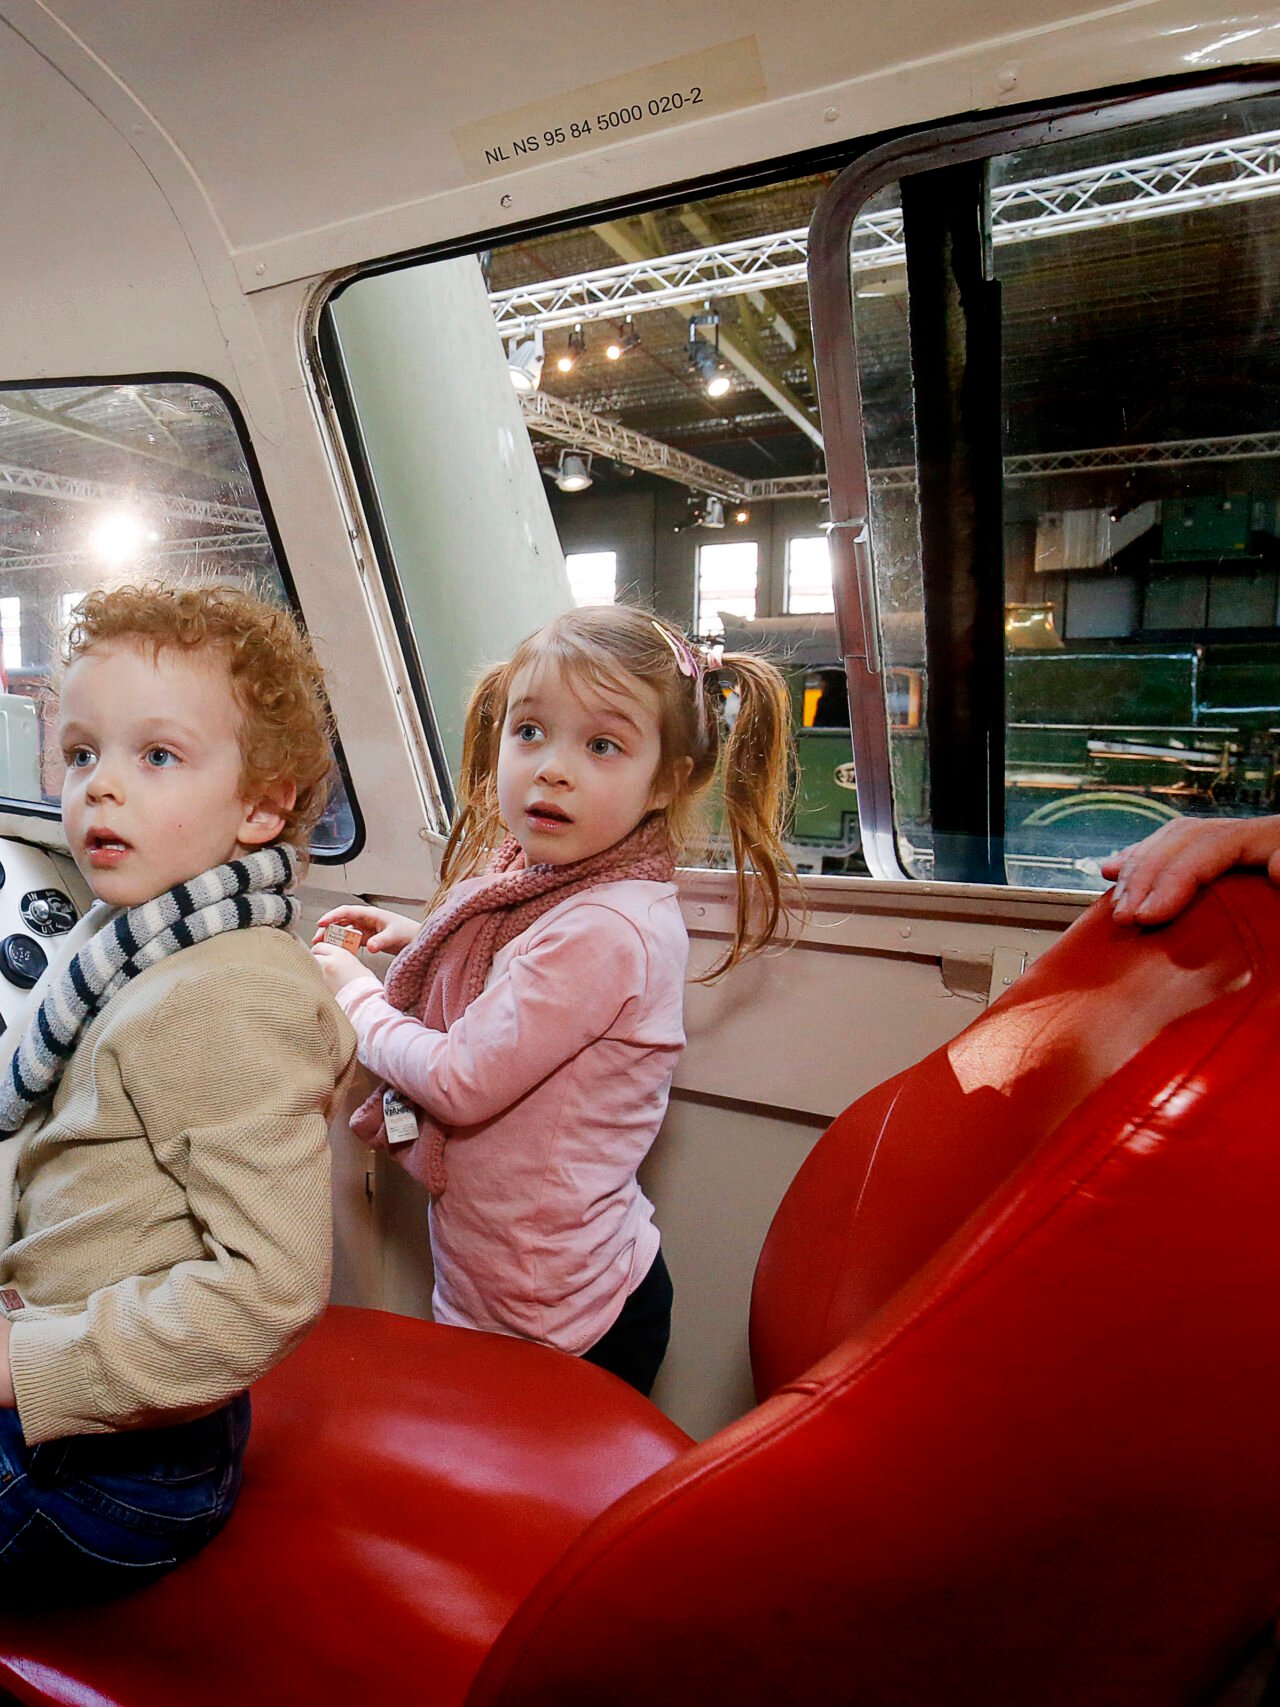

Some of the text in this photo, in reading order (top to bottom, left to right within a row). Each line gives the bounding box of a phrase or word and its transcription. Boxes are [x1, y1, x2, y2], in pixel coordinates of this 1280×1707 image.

[484, 87, 704, 165] NL NS 95 84 5000 020-2
[26, 892, 39, 902] IN
